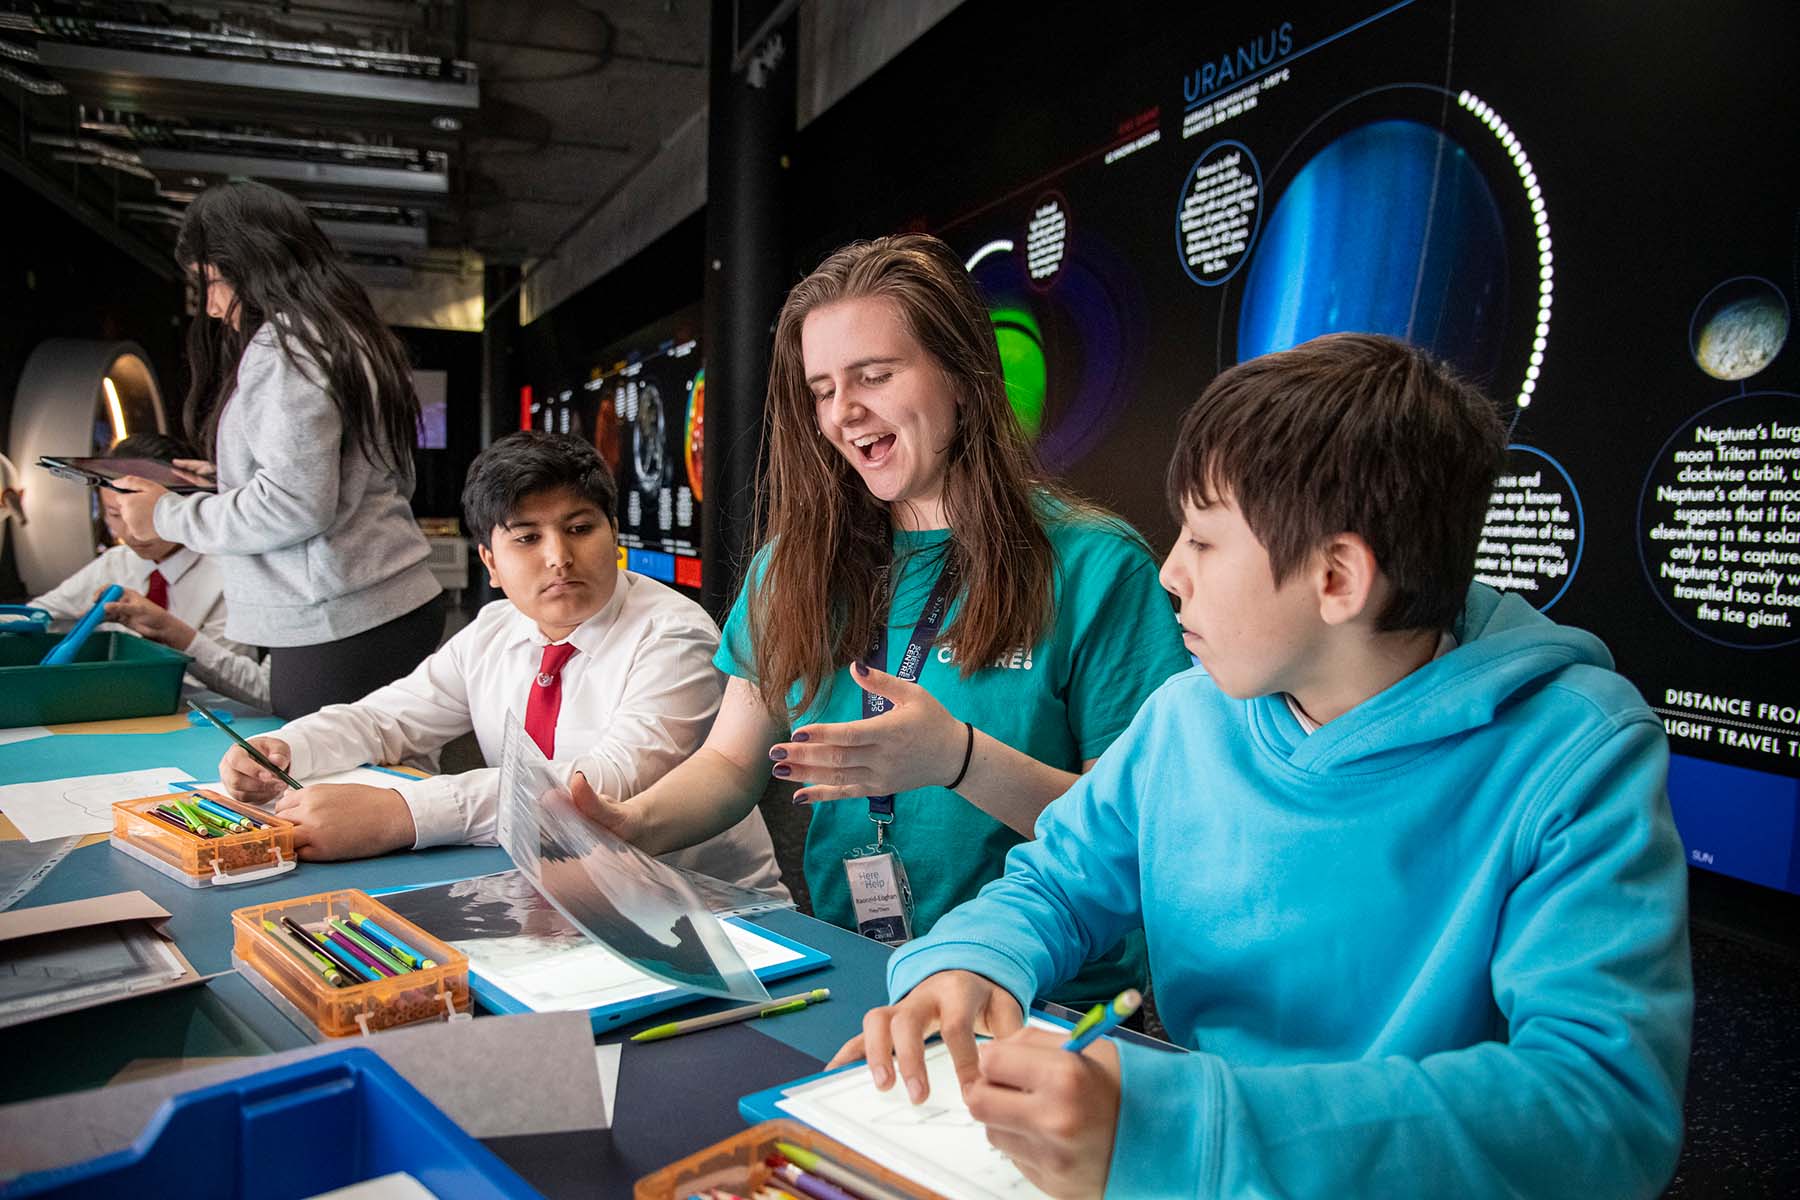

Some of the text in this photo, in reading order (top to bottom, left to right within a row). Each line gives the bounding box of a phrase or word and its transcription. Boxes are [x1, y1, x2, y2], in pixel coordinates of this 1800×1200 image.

[1183, 21, 1294, 102] URANUS
[1695, 422, 1768, 446] Neptune's
[1674, 445, 1800, 464] moon Triton move
[1518, 471, 1541, 488] and
[1677, 464, 1745, 483] clockwise
[1747, 464, 1788, 484] orbit,
[1525, 488, 1562, 505] known
[1656, 485, 1725, 506] Neptune's
[1727, 485, 1767, 502] other
[1515, 505, 1537, 522] due
[1537, 507, 1550, 522] to
[1550, 505, 1570, 523] the
[1674, 507, 1733, 526] suggests
[1735, 505, 1763, 522] that
[1766, 506, 1778, 522] it
[1538, 522, 1552, 540] of
[1650, 522, 1718, 542] elsewhere
[1719, 527, 1735, 542] in
[1737, 525, 1761, 543] the
[1511, 542, 1566, 560] ammonia,
[1669, 543, 1800, 567] only to be capture
[1500, 557, 1512, 571] in
[1512, 556, 1537, 573] their
[1660, 562, 1730, 584] Neptune's
[1731, 570, 1784, 588] gravity
[1673, 583, 1800, 607] travelled too close
[1697, 604, 1792, 629] the ice giant.
[1665, 688, 1751, 717] DISTANCE
[1664, 719, 1712, 741] LIGHT
[1717, 728, 1780, 754] TRAVEL
[1692, 849, 1713, 865] SUN
[865, 880, 885, 889] Help
